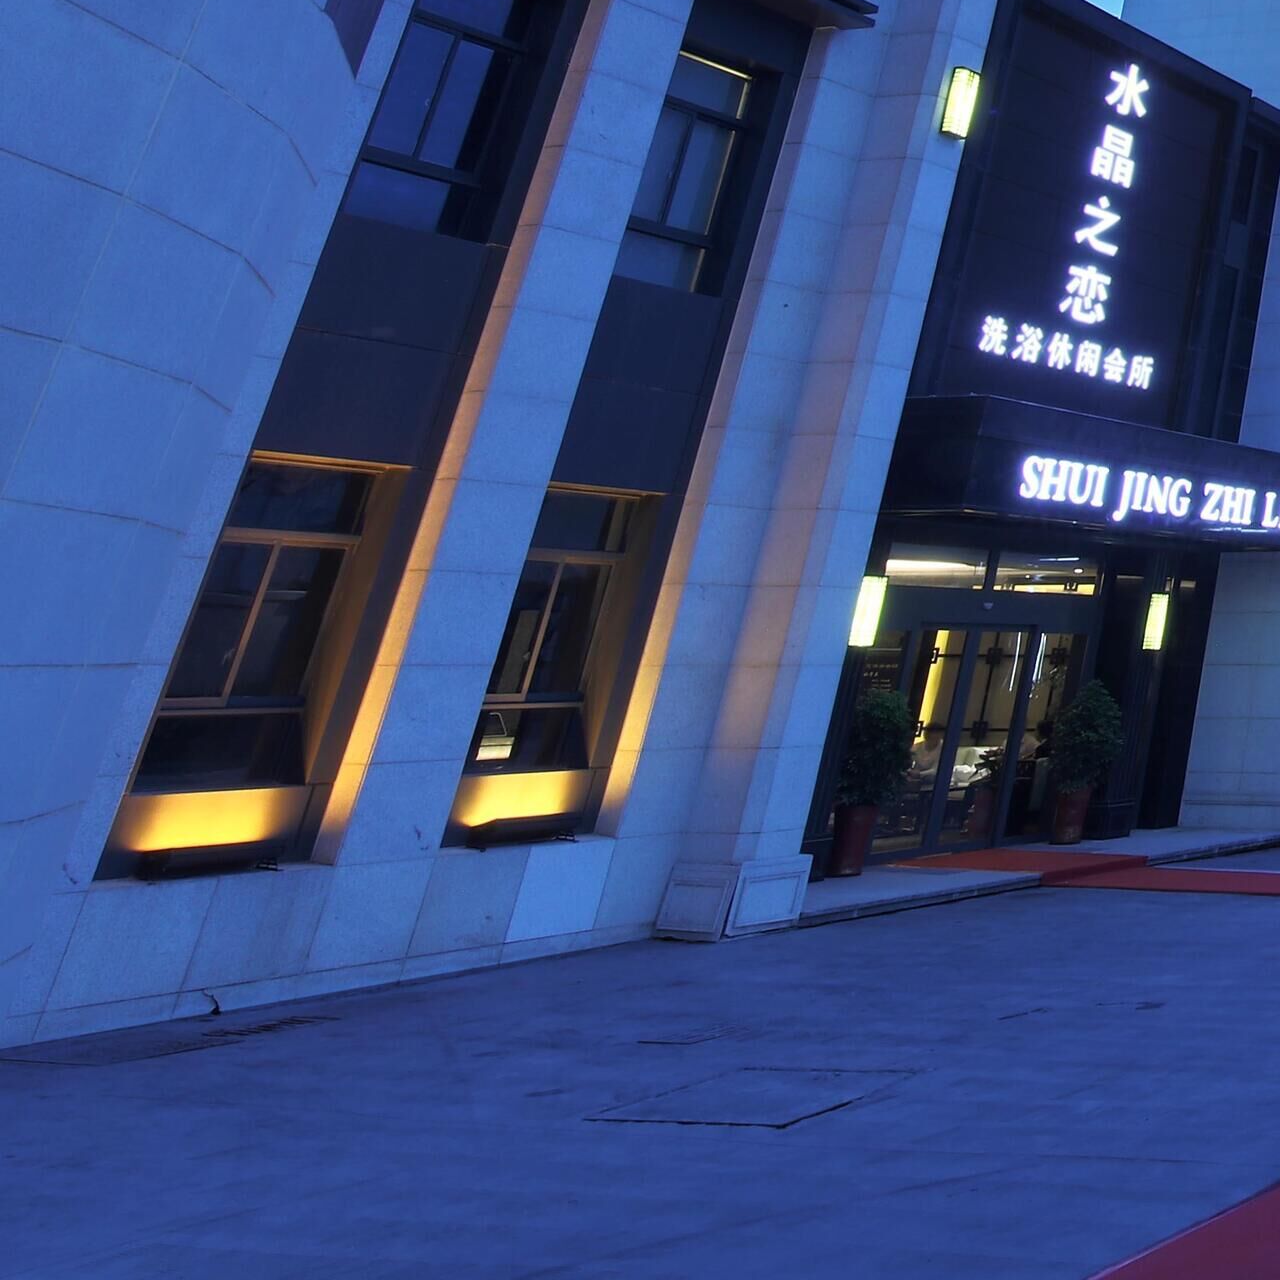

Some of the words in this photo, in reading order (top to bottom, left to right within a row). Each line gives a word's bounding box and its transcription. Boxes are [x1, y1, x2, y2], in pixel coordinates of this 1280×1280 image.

[1060, 64, 1149, 323] 水晶之恋
[978, 315, 1154, 390] 洗浴休闲会所
[1019, 455, 1110, 507] SHUI
[1113, 469, 1193, 521] JING
[1200, 482, 1257, 525] ZHI
